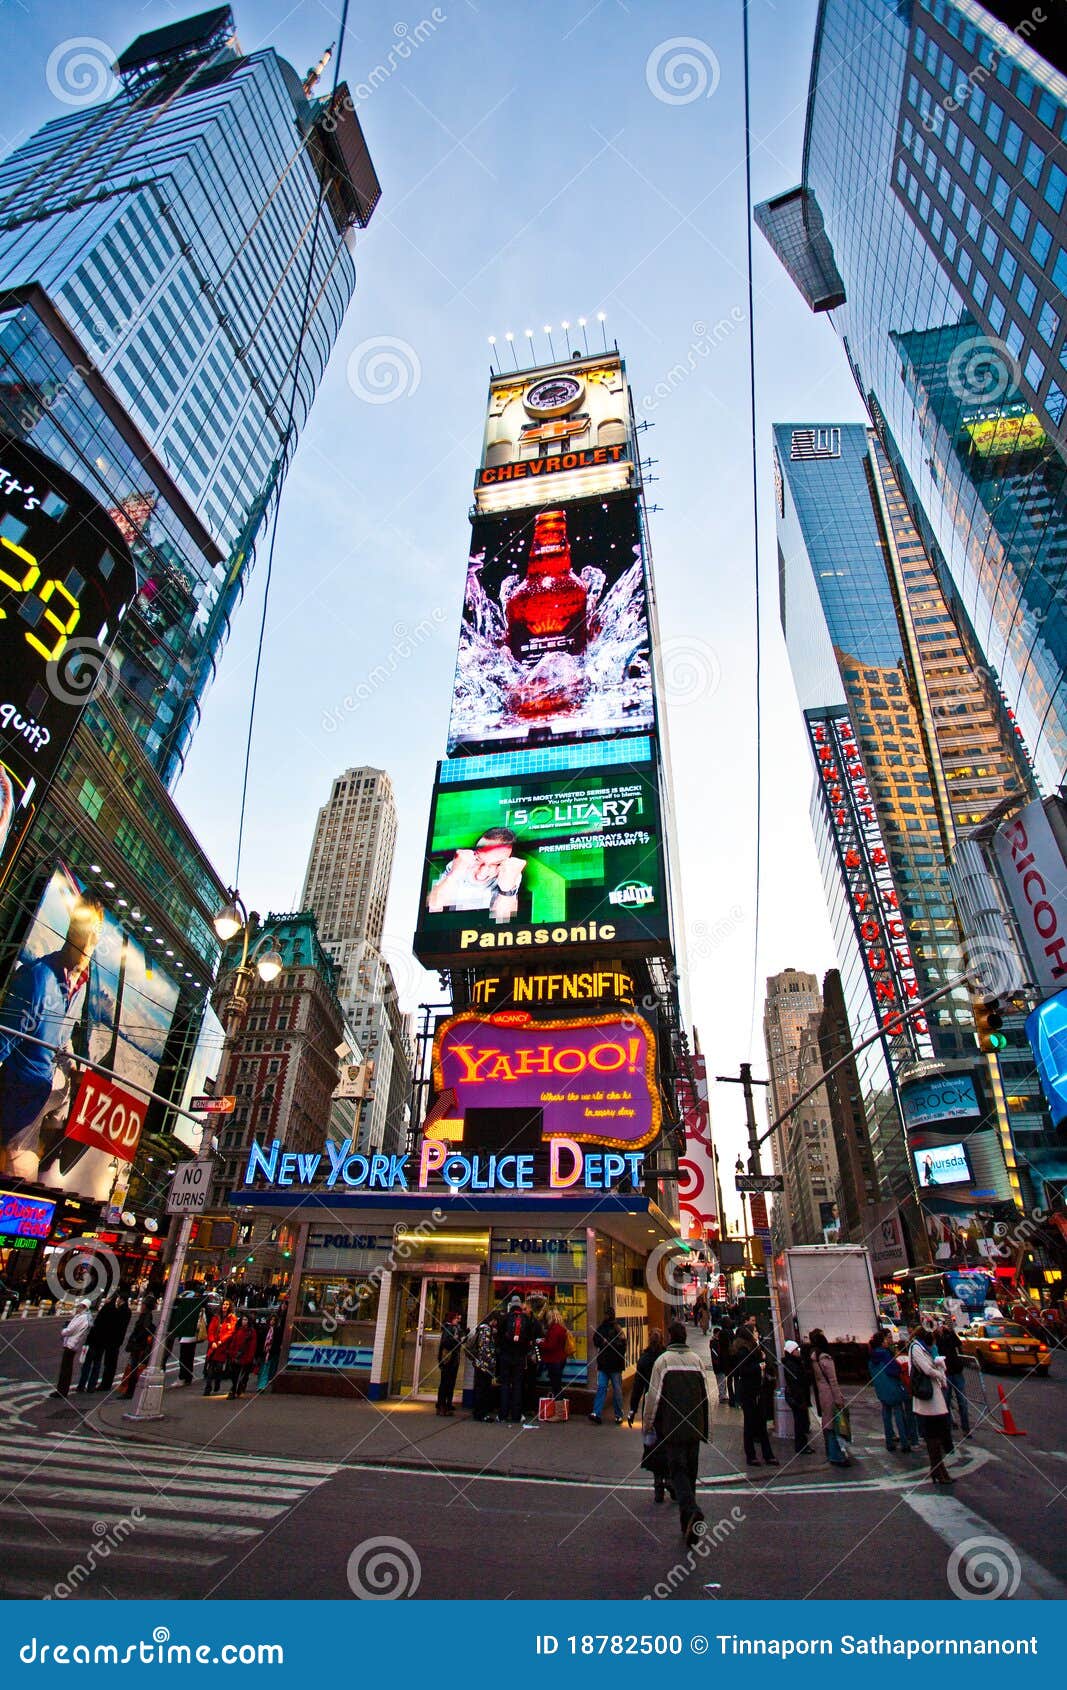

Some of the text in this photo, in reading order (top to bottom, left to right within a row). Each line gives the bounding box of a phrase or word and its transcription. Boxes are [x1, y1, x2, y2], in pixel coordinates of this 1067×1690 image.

[481, 444, 624, 485] CHEVROLET
[520, 638, 575, 653] SELECT
[0, 704, 51, 752] quit?
[499, 796, 532, 805] REALITY'S
[533, 794, 553, 802] MOST
[554, 791, 586, 800] TWISTED
[587, 788, 611, 796] SERIES
[538, 836, 650, 853] PREMIERING JANUARY 17
[570, 832, 622, 844] SATURDAYS
[1003, 820, 1067, 979] RICOH
[460, 921, 616, 949] Panasonic
[493, 1014, 528, 1024] VACANCY
[447, 1037, 642, 1083] YAHOO!
[75, 1085, 142, 1147] IZOD
[182, 1168, 202, 1185] NO
[171, 1192, 206, 1206] TURNS
[323, 1234, 377, 1250] POLICE
[510, 1238, 568, 1253] POLICE
[309, 1347, 358, 1366] NYPD
